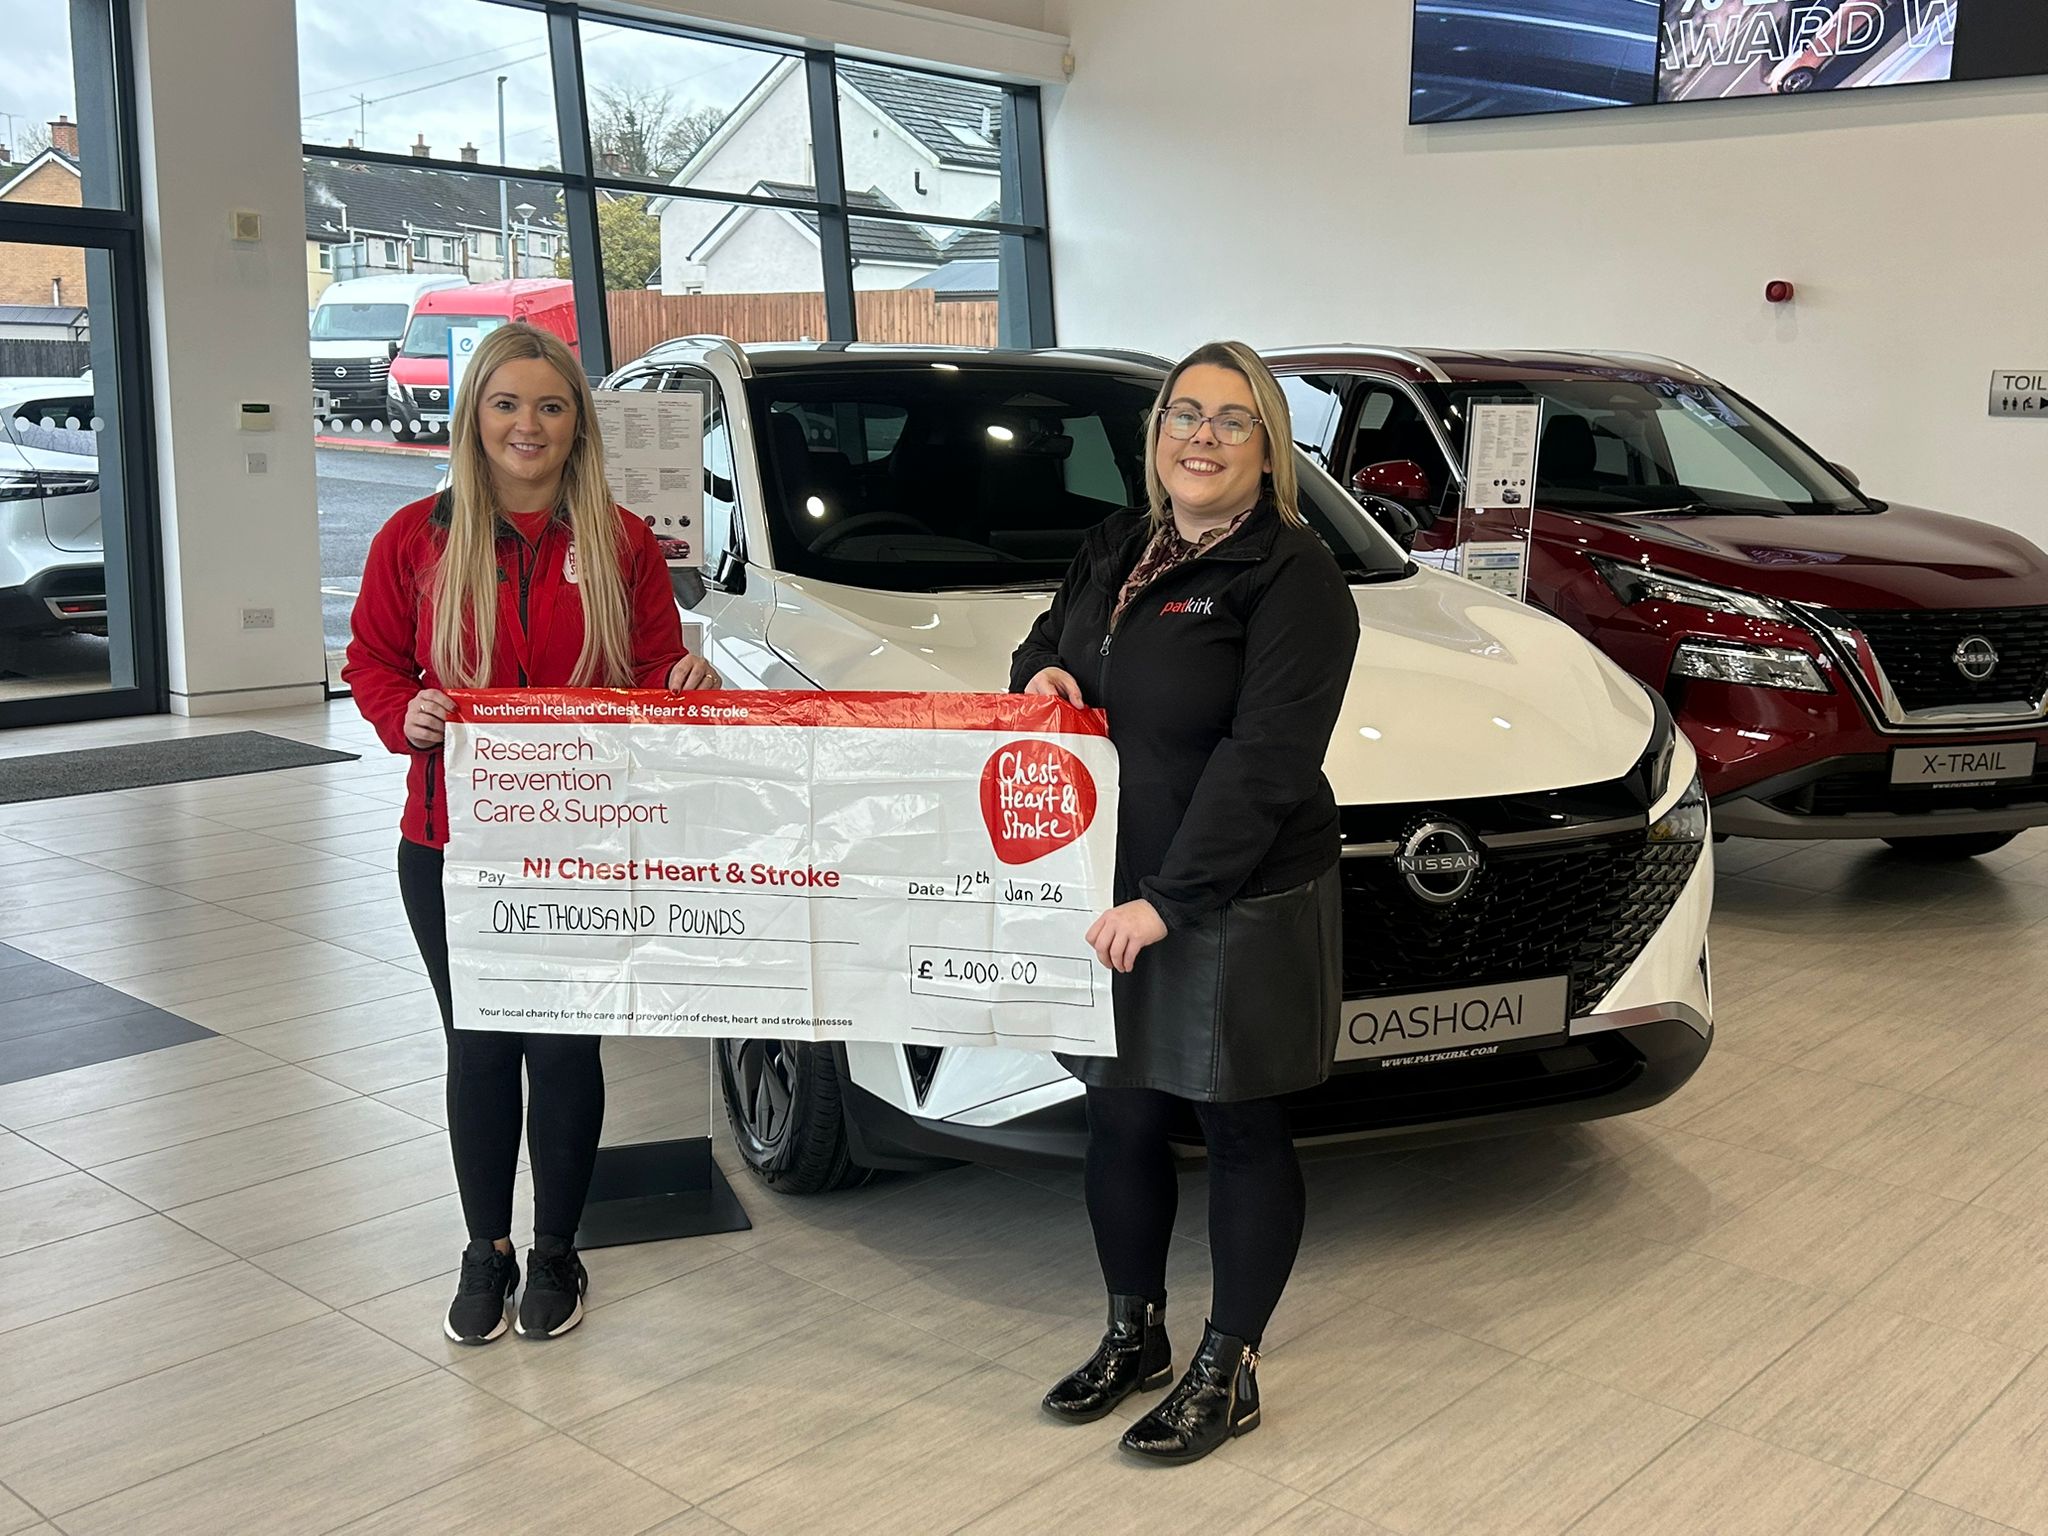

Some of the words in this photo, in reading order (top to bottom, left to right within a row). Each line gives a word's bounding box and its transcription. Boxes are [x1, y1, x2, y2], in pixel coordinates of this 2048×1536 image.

[2003, 375, 2047, 390] TOIL
[1159, 596, 1214, 616] patkirk
[1953, 652, 1999, 664] NISSAN
[473, 703, 541, 717] Northern
[543, 703, 594, 717] Ireland
[597, 703, 640, 716] Chest
[643, 704, 685, 717] Heart
[687, 705, 699, 717] &
[700, 705, 749, 718] Stroke
[475, 737, 593, 761] Research
[998, 750, 1060, 785] Chest
[1922, 752, 2006, 774] X-TRAIL
[472, 768, 611, 791] Prevention
[1000, 780, 1060, 813] Heart
[1060, 784, 1077, 816] &
[473, 799, 535, 822] Care
[538, 799, 560, 822] &
[565, 799, 669, 828] Support
[1002, 810, 1071, 840] Stroke
[523, 858, 551, 879] NI
[558, 859, 638, 881] Chest
[645, 861, 719, 883] Heart
[726, 863, 745, 884] &
[751, 865, 840, 887] Stroke
[1401, 852, 1479, 871] NISSAN
[478, 870, 505, 885] Pay
[908, 882, 945, 897] Date
[1004, 879, 1034, 902] Jan
[1040, 884, 1063, 902] 26
[669, 904, 745, 936] POUNDS
[917, 960, 933, 980] £
[479, 1007, 500, 1016] Your
[502, 1008, 524, 1017] local
[526, 1009, 558, 1020] charity
[560, 1009, 574, 1019] for
[576, 1010, 593, 1019] the
[617, 1012, 634, 1020] and
[636, 1013, 689, 1023] prevention
[690, 1013, 699, 1022] of
[701, 1014, 730, 1024] chest,
[731, 1015, 758, 1024] heart
[761, 1016, 780, 1025] and
[781, 1016, 811, 1026] stroke
[812, 1018, 853, 1027] illnesses
[1348, 994, 1523, 1046] QASHQAI
[1381, 1045, 1499, 1068] WWW.PATKIRK.COM
